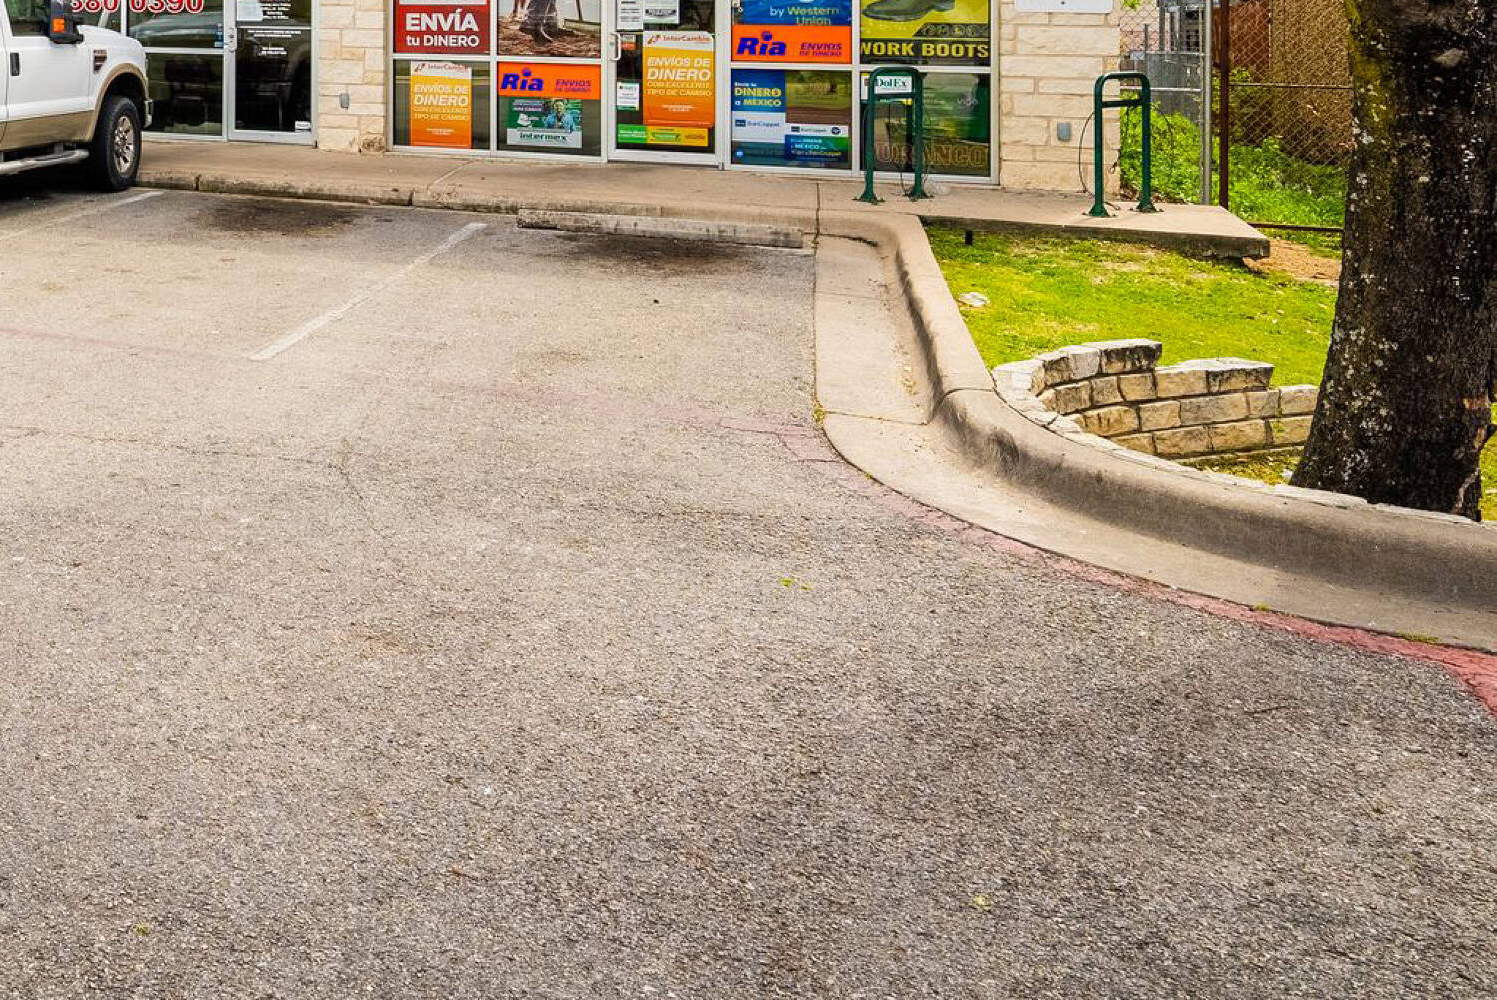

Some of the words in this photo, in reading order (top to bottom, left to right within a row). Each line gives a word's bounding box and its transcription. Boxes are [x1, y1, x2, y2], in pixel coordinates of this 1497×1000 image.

[770, 6, 783, 17] by
[787, 6, 839, 15] Western
[405, 8, 479, 31] ENVÍA
[796, 15, 831, 25] Union
[406, 34, 420, 46] tu
[423, 34, 479, 47] DINERO
[737, 31, 787, 56] Ria
[921, 43, 989, 58] BOOTS
[694, 58, 711, 67] DE
[500, 68, 544, 91] Ria
[646, 68, 711, 81] DINERO
[454, 85, 469, 94] DE
[734, 87, 781, 98] DINERO
[414, 95, 469, 107] DINERO
